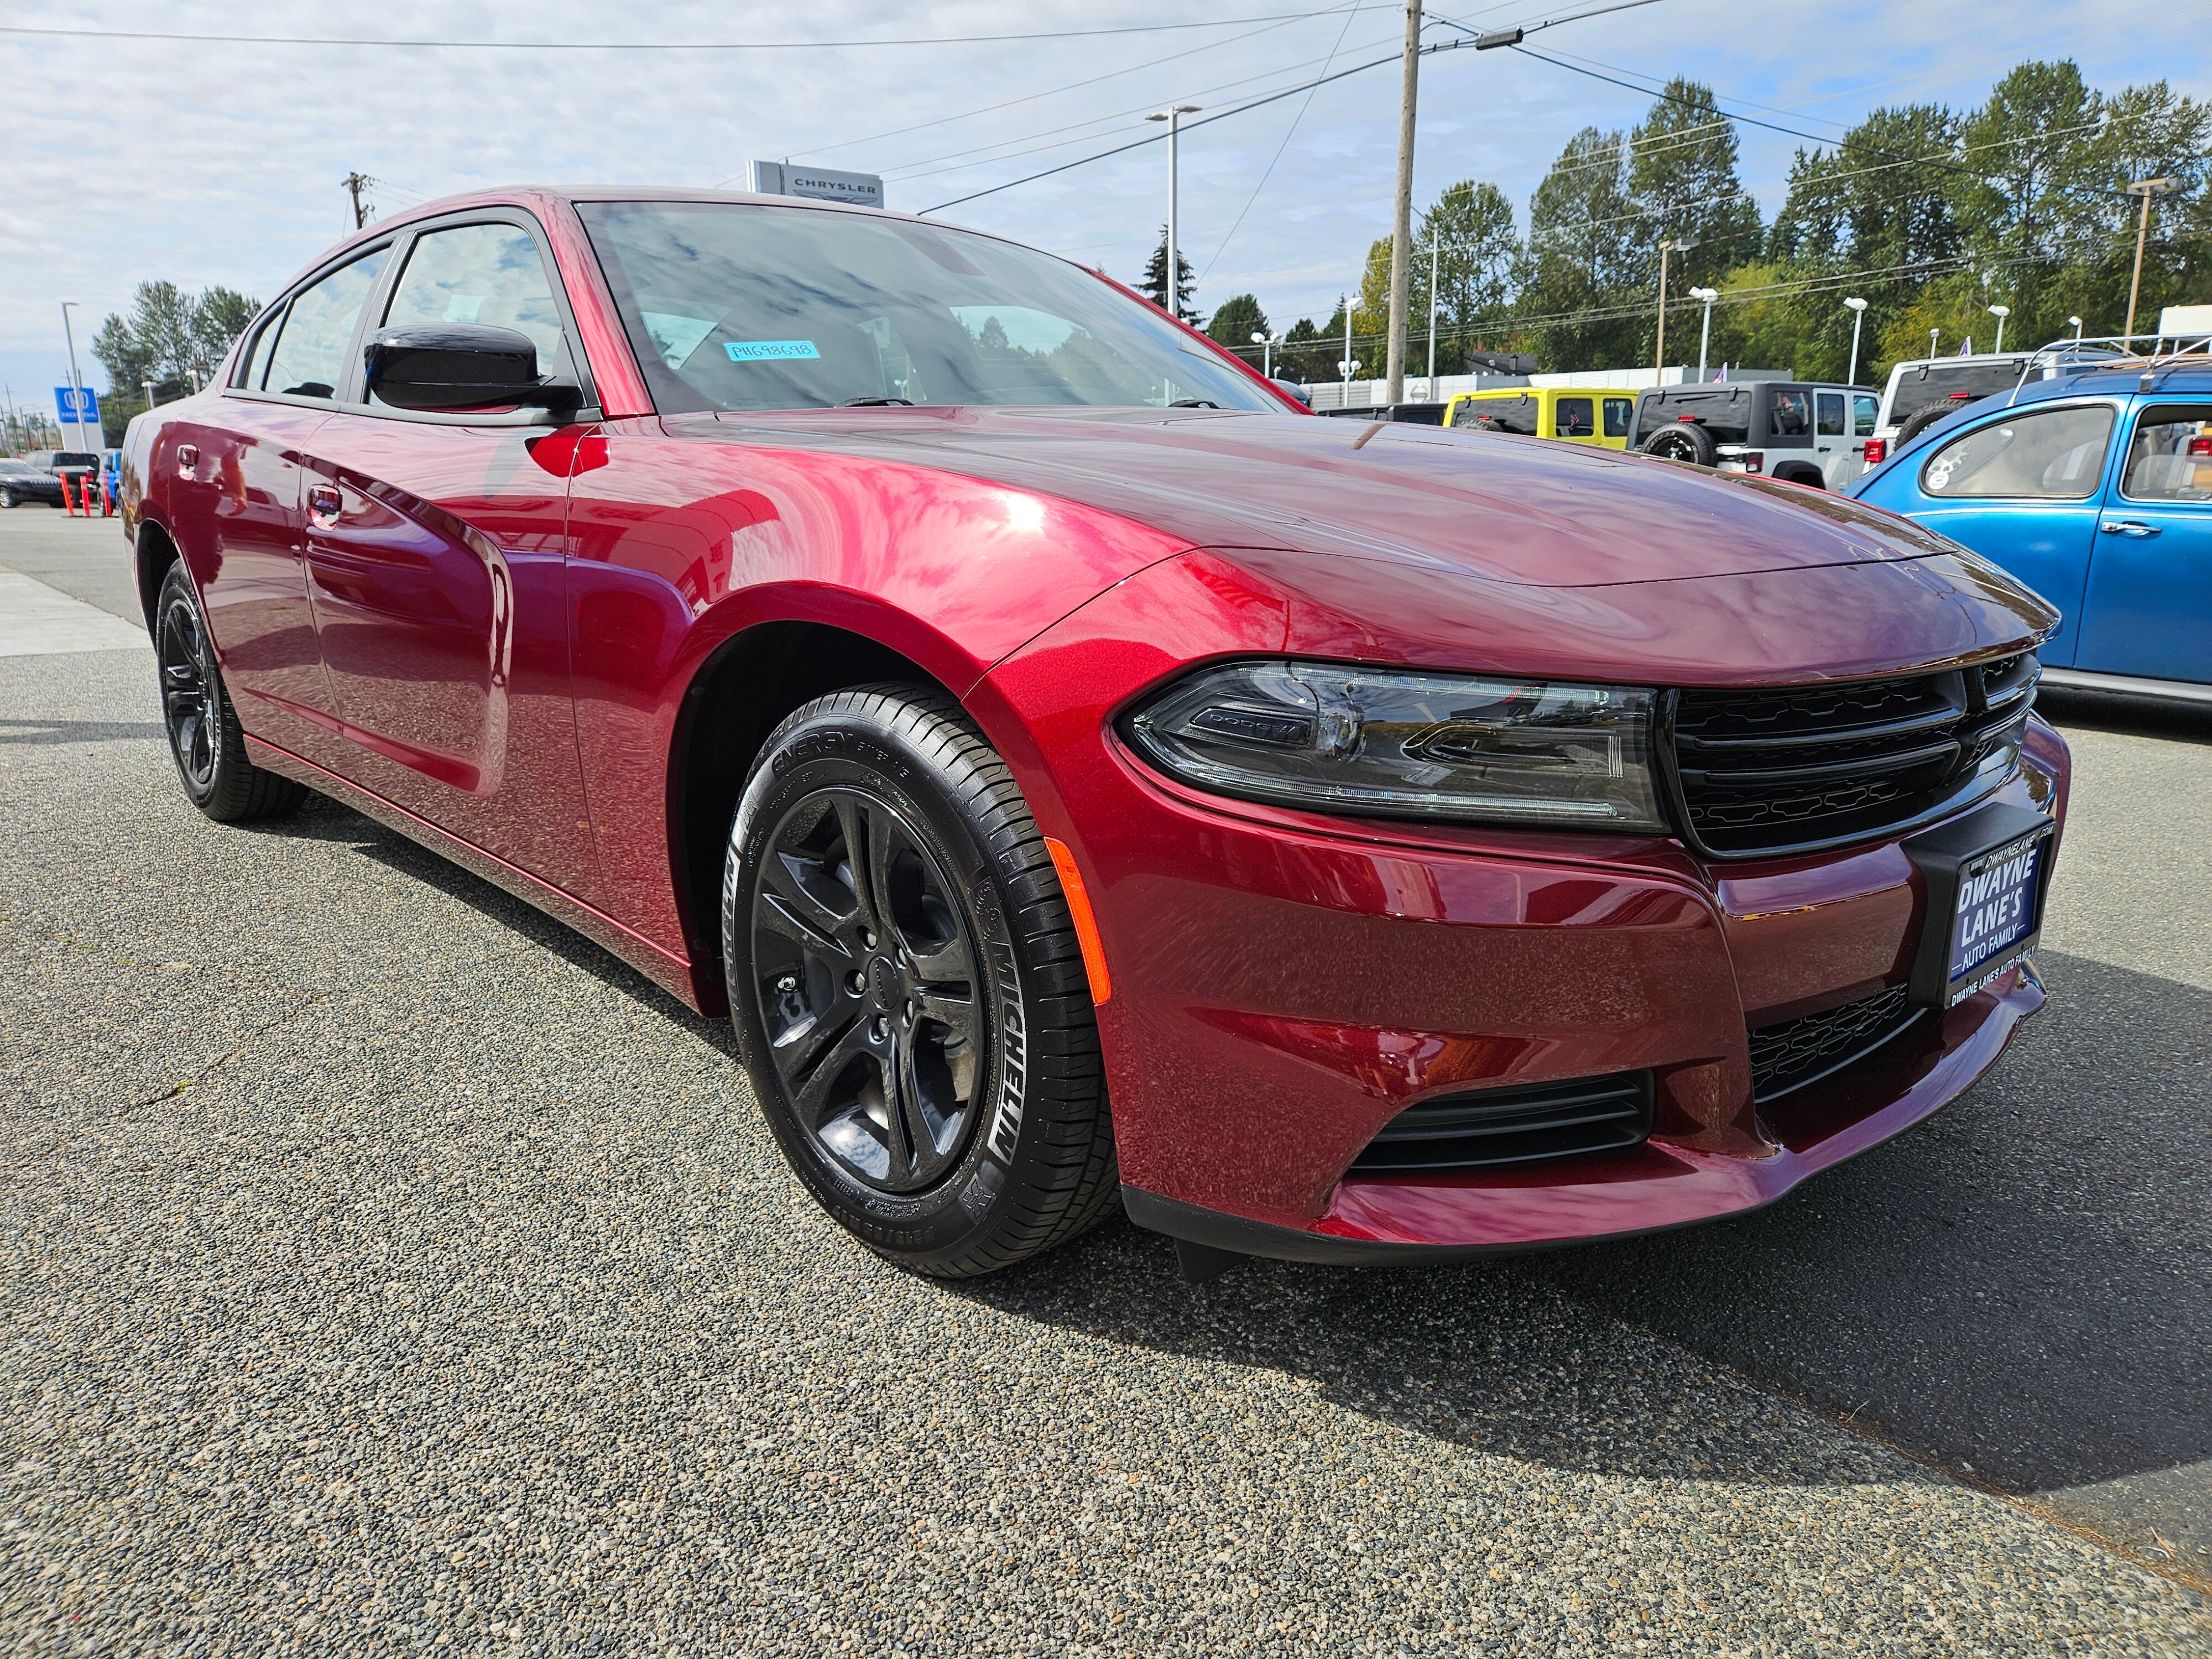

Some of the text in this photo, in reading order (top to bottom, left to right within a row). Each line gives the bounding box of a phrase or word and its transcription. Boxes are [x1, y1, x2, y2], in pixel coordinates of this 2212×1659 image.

[794, 178, 876, 194] CHRYSLER
[1209, 713, 1285, 733] DODGE
[771, 731, 854, 777] ENERGY
[1985, 834, 2036, 869] DWAYNELANE
[1957, 848, 2037, 914] DWAYNE
[1961, 886, 2023, 948] LANE'S
[1961, 922, 2018, 972] AUTO FAMILY
[1951, 944, 2036, 1007] DWAYNE LANE'S AUTO FAMILY
[989, 941, 1026, 1164] MICHELIN
